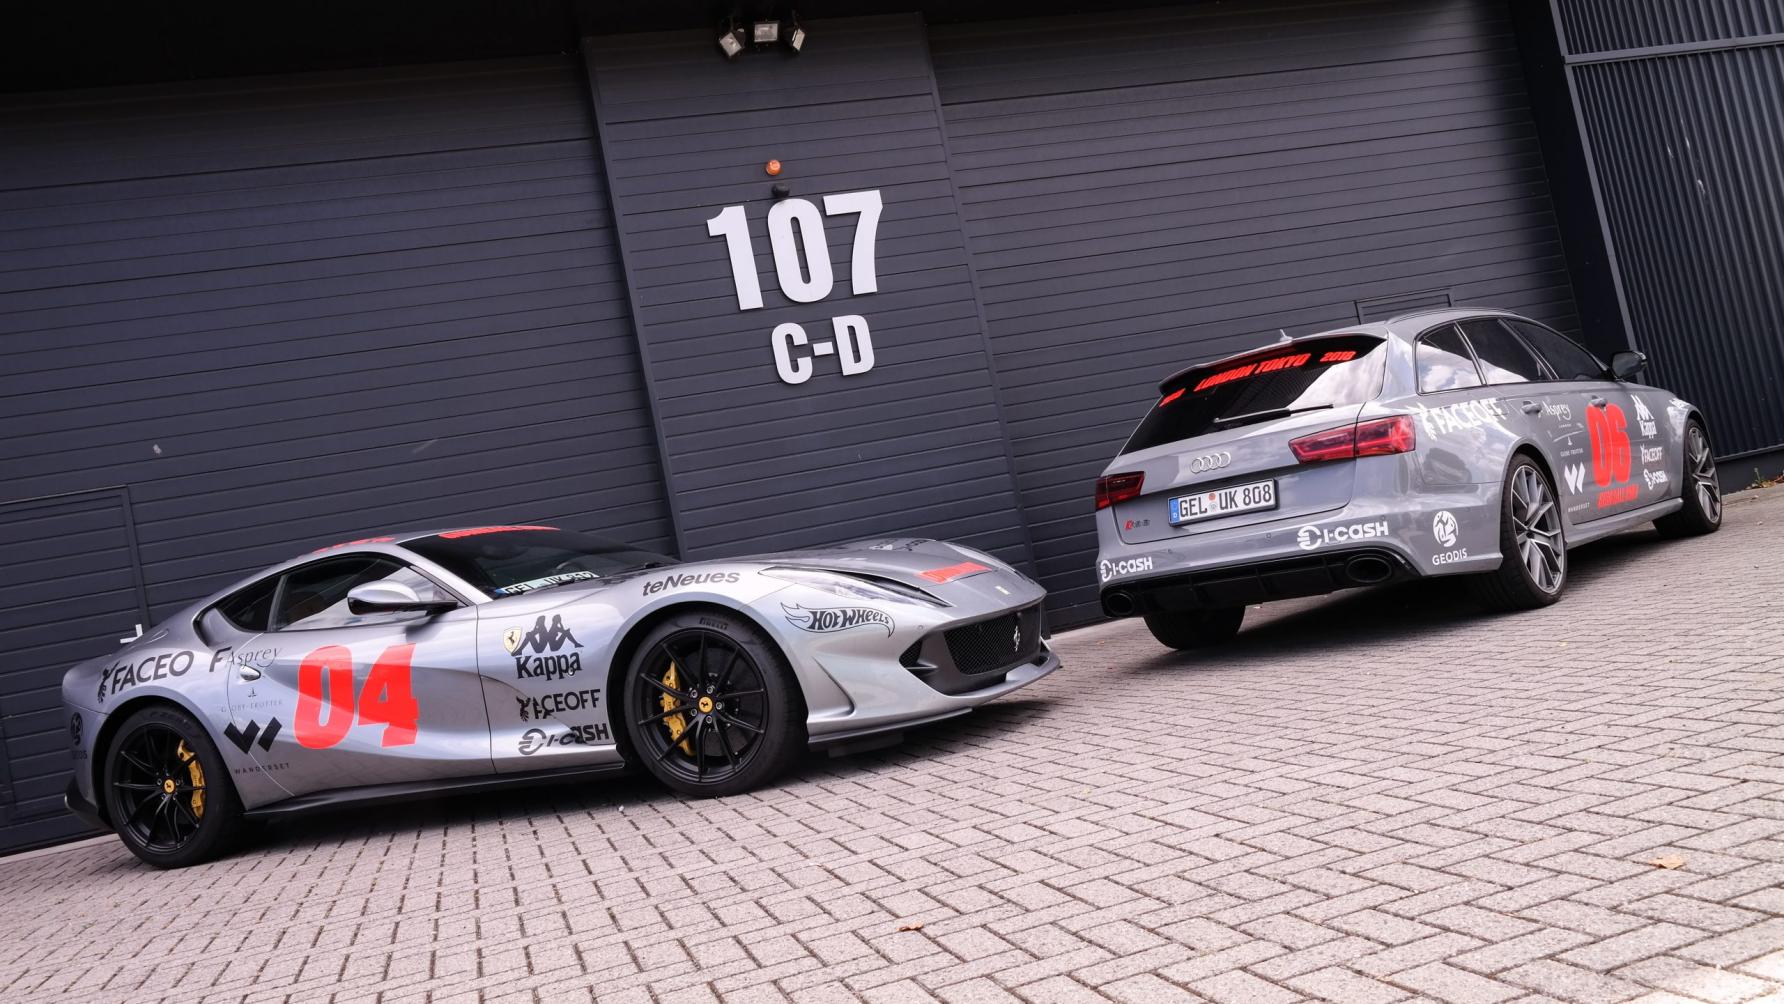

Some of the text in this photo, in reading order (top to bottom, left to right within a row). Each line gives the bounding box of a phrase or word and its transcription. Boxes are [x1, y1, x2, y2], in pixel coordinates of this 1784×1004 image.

[707, 190, 883, 310] 107
[771, 314, 875, 384] C-D
[1193, 362, 1257, 392] LONDON
[1254, 353, 1311, 375] TOKYO
[1585, 403, 1631, 487] 06
[1640, 420, 1657, 439] Kappa
[1179, 483, 1273, 518] GEL UK 808
[1432, 548, 1468, 566] GEODIS
[642, 571, 741, 597] teNeues
[225, 647, 284, 668] Asprey
[514, 651, 583, 681] Kappa
[293, 642, 421, 749] 04
[234, 762, 291, 775] WANDERSET
